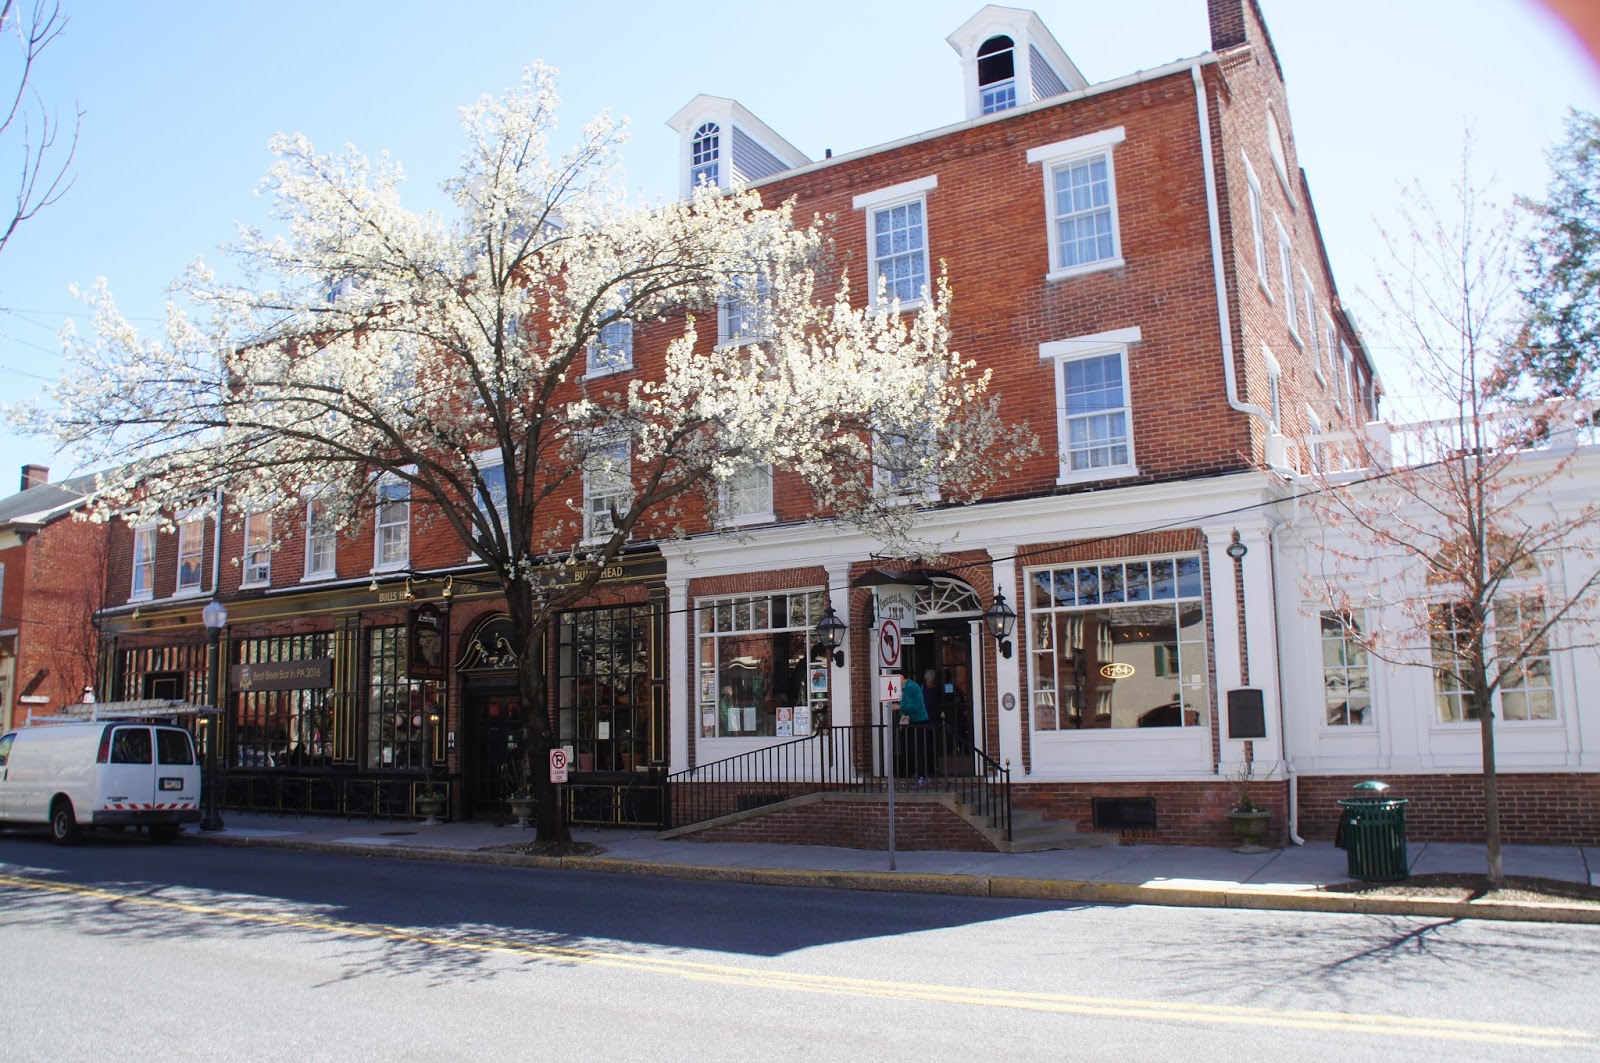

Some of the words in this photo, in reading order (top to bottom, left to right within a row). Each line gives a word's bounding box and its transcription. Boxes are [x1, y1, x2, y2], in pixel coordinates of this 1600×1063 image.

[601, 566, 623, 579] HEAD
[379, 591, 397, 602] BULLS
[889, 606, 904, 620] INN
[253, 671, 265, 681] Best
[265, 670, 279, 680] Beer
[279, 670, 289, 679] Bar
[290, 669, 296, 678] in
[296, 668, 305, 678] PA
[306, 667, 321, 677] 2016
[1107, 665, 1129, 677] 1764
